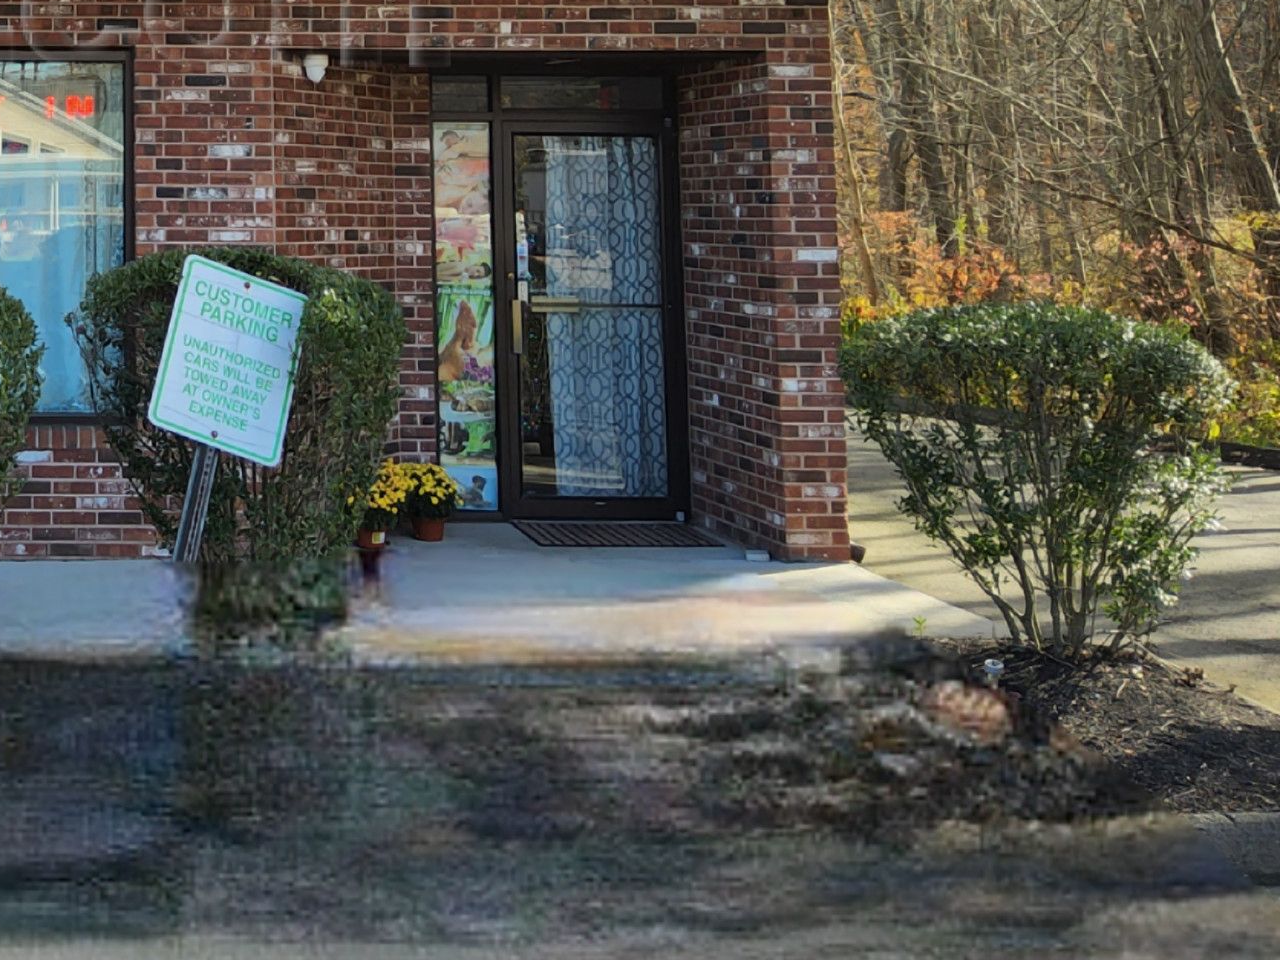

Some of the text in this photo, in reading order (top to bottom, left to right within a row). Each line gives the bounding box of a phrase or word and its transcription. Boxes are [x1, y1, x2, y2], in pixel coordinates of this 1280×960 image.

[44, 95, 94, 120] IN
[195, 280, 294, 329] CUSTOMER
[200, 301, 279, 343] PARKING
[183, 334, 281, 380] UNAUTHORIZED
[184, 352, 273, 392] CARS WILL BE
[182, 383, 261, 420] AT OWNER'S
[183, 366, 268, 407] TOWED AWAY
[189, 401, 249, 432] EXPENSE
